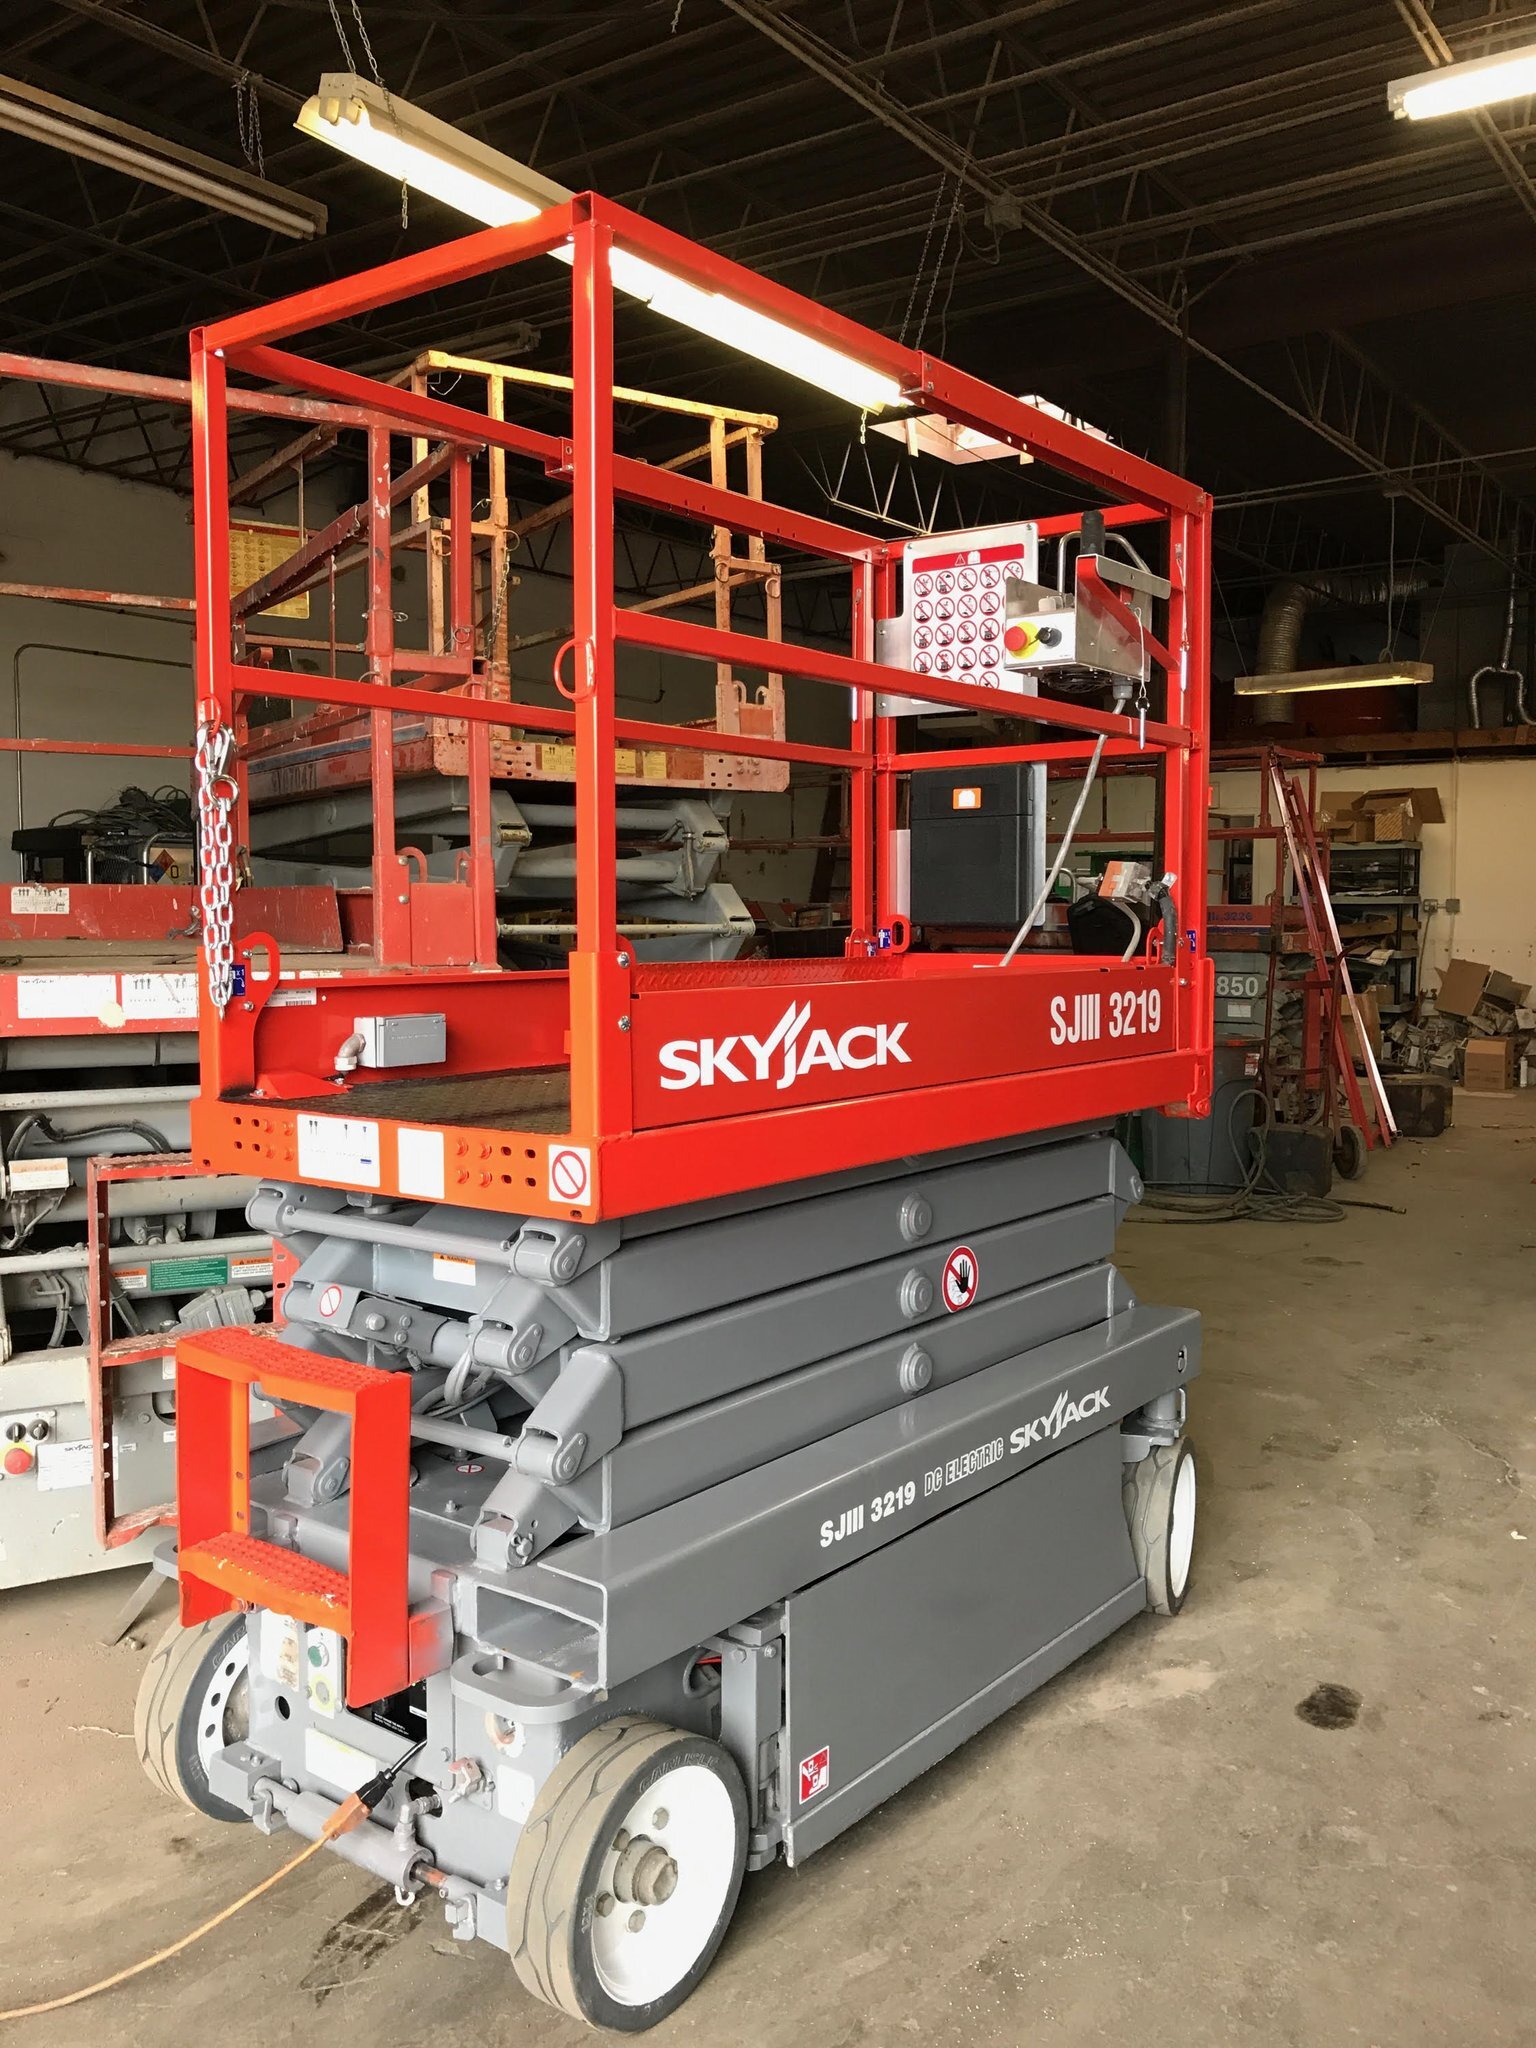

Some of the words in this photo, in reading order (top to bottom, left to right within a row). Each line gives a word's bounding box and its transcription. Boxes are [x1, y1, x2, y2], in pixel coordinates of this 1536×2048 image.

[1109, 988, 1161, 1038] 3219
[1217, 976, 1259, 996] 850
[658, 1000, 912, 1090] SKYJACK
[870, 1481, 916, 1522] 3219
[924, 1467, 943, 1497] DC
[945, 1437, 1004, 1487] ELECTRIC
[1010, 1386, 1111, 1454] SKYJACK
